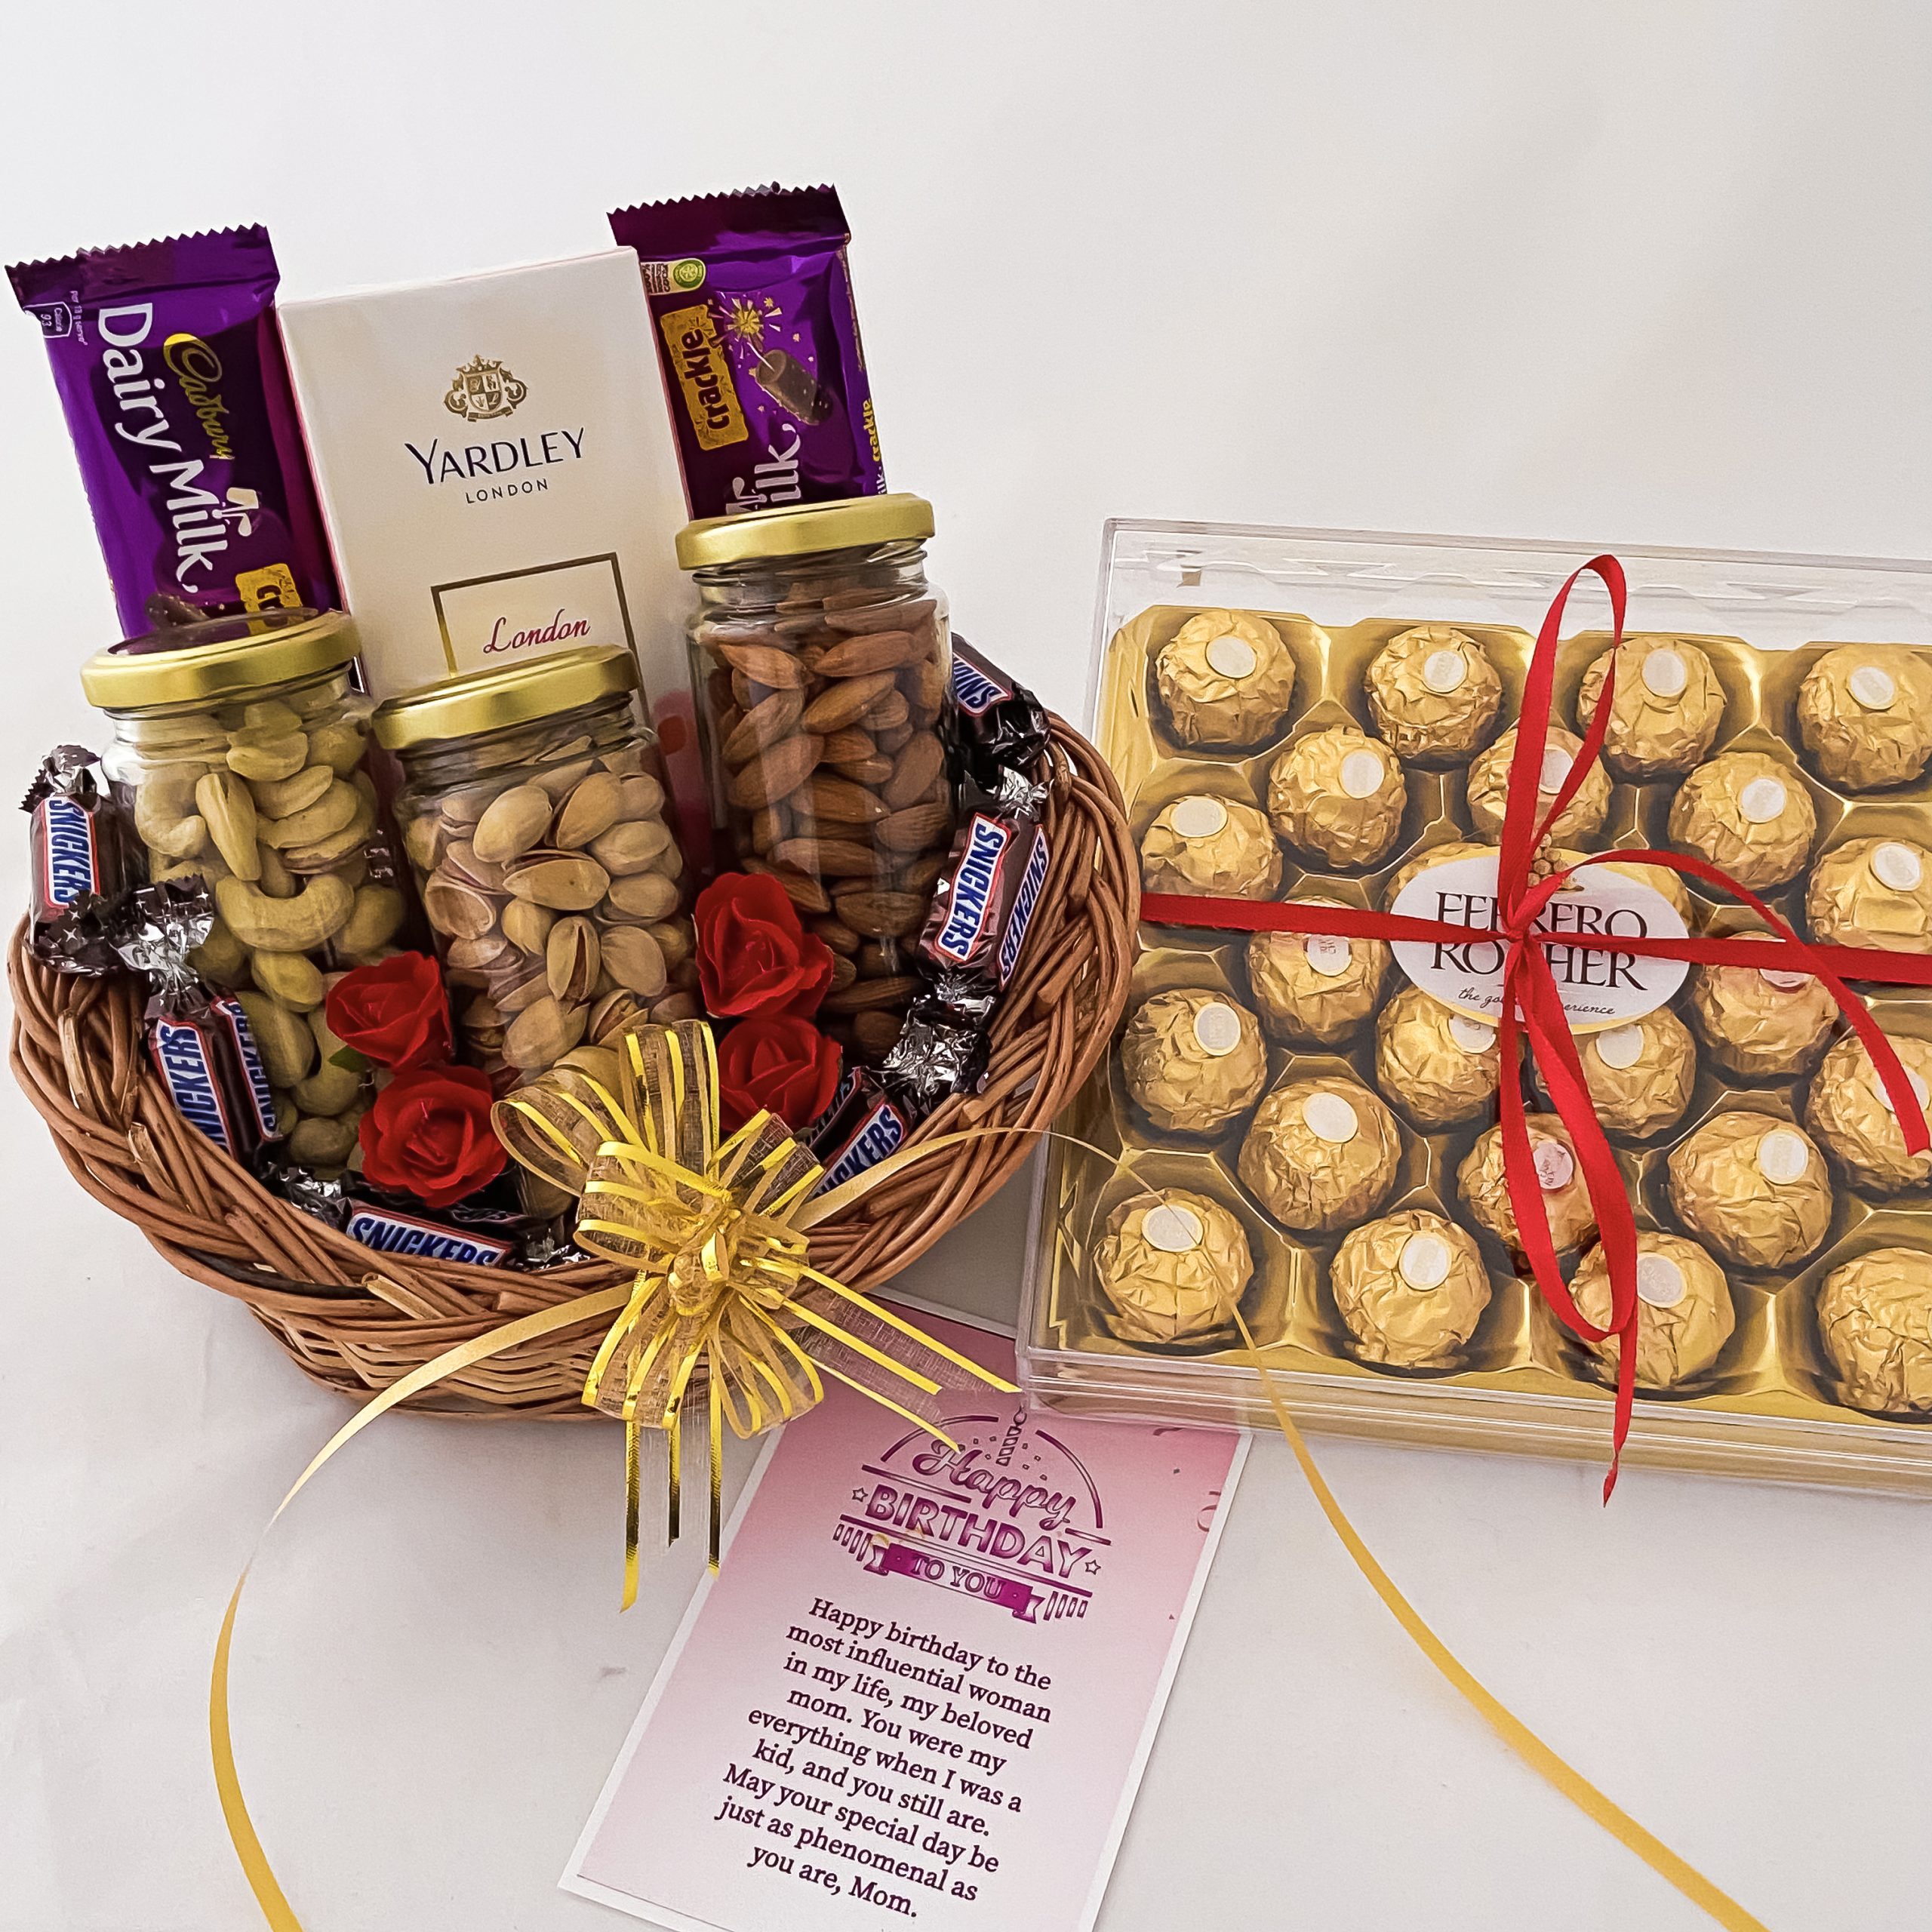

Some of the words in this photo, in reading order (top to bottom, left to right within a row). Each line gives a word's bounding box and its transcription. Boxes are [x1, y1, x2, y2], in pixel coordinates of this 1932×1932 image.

[41, 313, 52, 326] 93
[163, 333, 235, 460] Cadbury
[681, 328, 730, 429] crackle
[97, 303, 182, 452] Dairy
[149, 460, 228, 594] Milk
[405, 427, 585, 485] YARDLEY
[754, 423, 801, 503] ilk
[863, 398, 881, 462] crackle
[466, 478, 548, 503] LONDON
[875, 472, 888, 494] ilk
[483, 608, 591, 654] London
[49, 800, 91, 903] SNICKERS
[942, 824, 1004, 959] SNICKERS
[1001, 835, 1047, 977] SNICKERS
[1431, 942, 1648, 991] ROHER
[1458, 987, 1481, 1001] the
[1564, 1003, 1616, 1015] erience
[160, 1025, 231, 1155] ICKERS
[865, 1484, 1093, 1579] BIRTHDAY
[912, 1438, 1076, 1531] Happy
[910, 1552, 946, 1580] TO
[950, 1565, 1007, 1600] YOU
[786, 1625, 844, 1656] most
[845, 1639, 964, 1694] influential
[969, 1684, 1051, 1723] woman
[808, 1597, 884, 1639] Happy
[885, 1621, 984, 1673] birthday
[986, 1655, 1009, 1676] to
[1014, 1664, 1051, 1690] the
[783, 1651, 808, 1675] in
[811, 1666, 851, 1692] my
[851, 1673, 894, 1709] life,
[900, 1695, 940, 1721] my
[940, 1702, 1034, 1749] beloved
[786, 1690, 853, 1724] mom.
[860, 1708, 902, 1740] You
[909, 1729, 964, 1758] were
[967, 1749, 1008, 1777] my
[748, 1709, 872, 1767] everything
[875, 1749, 937, 1785] when
[941, 1768, 957, 1789] I
[960, 1778, 1004, 1805] was
[1008, 1796, 1022, 1813] a
[752, 1738, 795, 1775] kid,
[801, 1761, 850, 1788] and
[847, 1775, 894, 1804] you
[897, 1793, 944, 1820] still
[946, 1810, 990, 1837] are.
[714, 1795, 765, 1829] just
[767, 1818, 794, 1838] as
[793, 1826, 949, 1891] phenomenal
[951, 1881, 978, 1901] as
[722, 1763, 776, 1799] May
[773, 1783, 833, 1816] your
[835, 1806, 919, 1846] special
[922, 1831, 967, 1866] day
[968, 1844, 999, 1873] be
[746, 1846, 795, 1875] you
[798, 1864, 841, 1896] are,
[848, 1875, 918, 1918] Mom.
